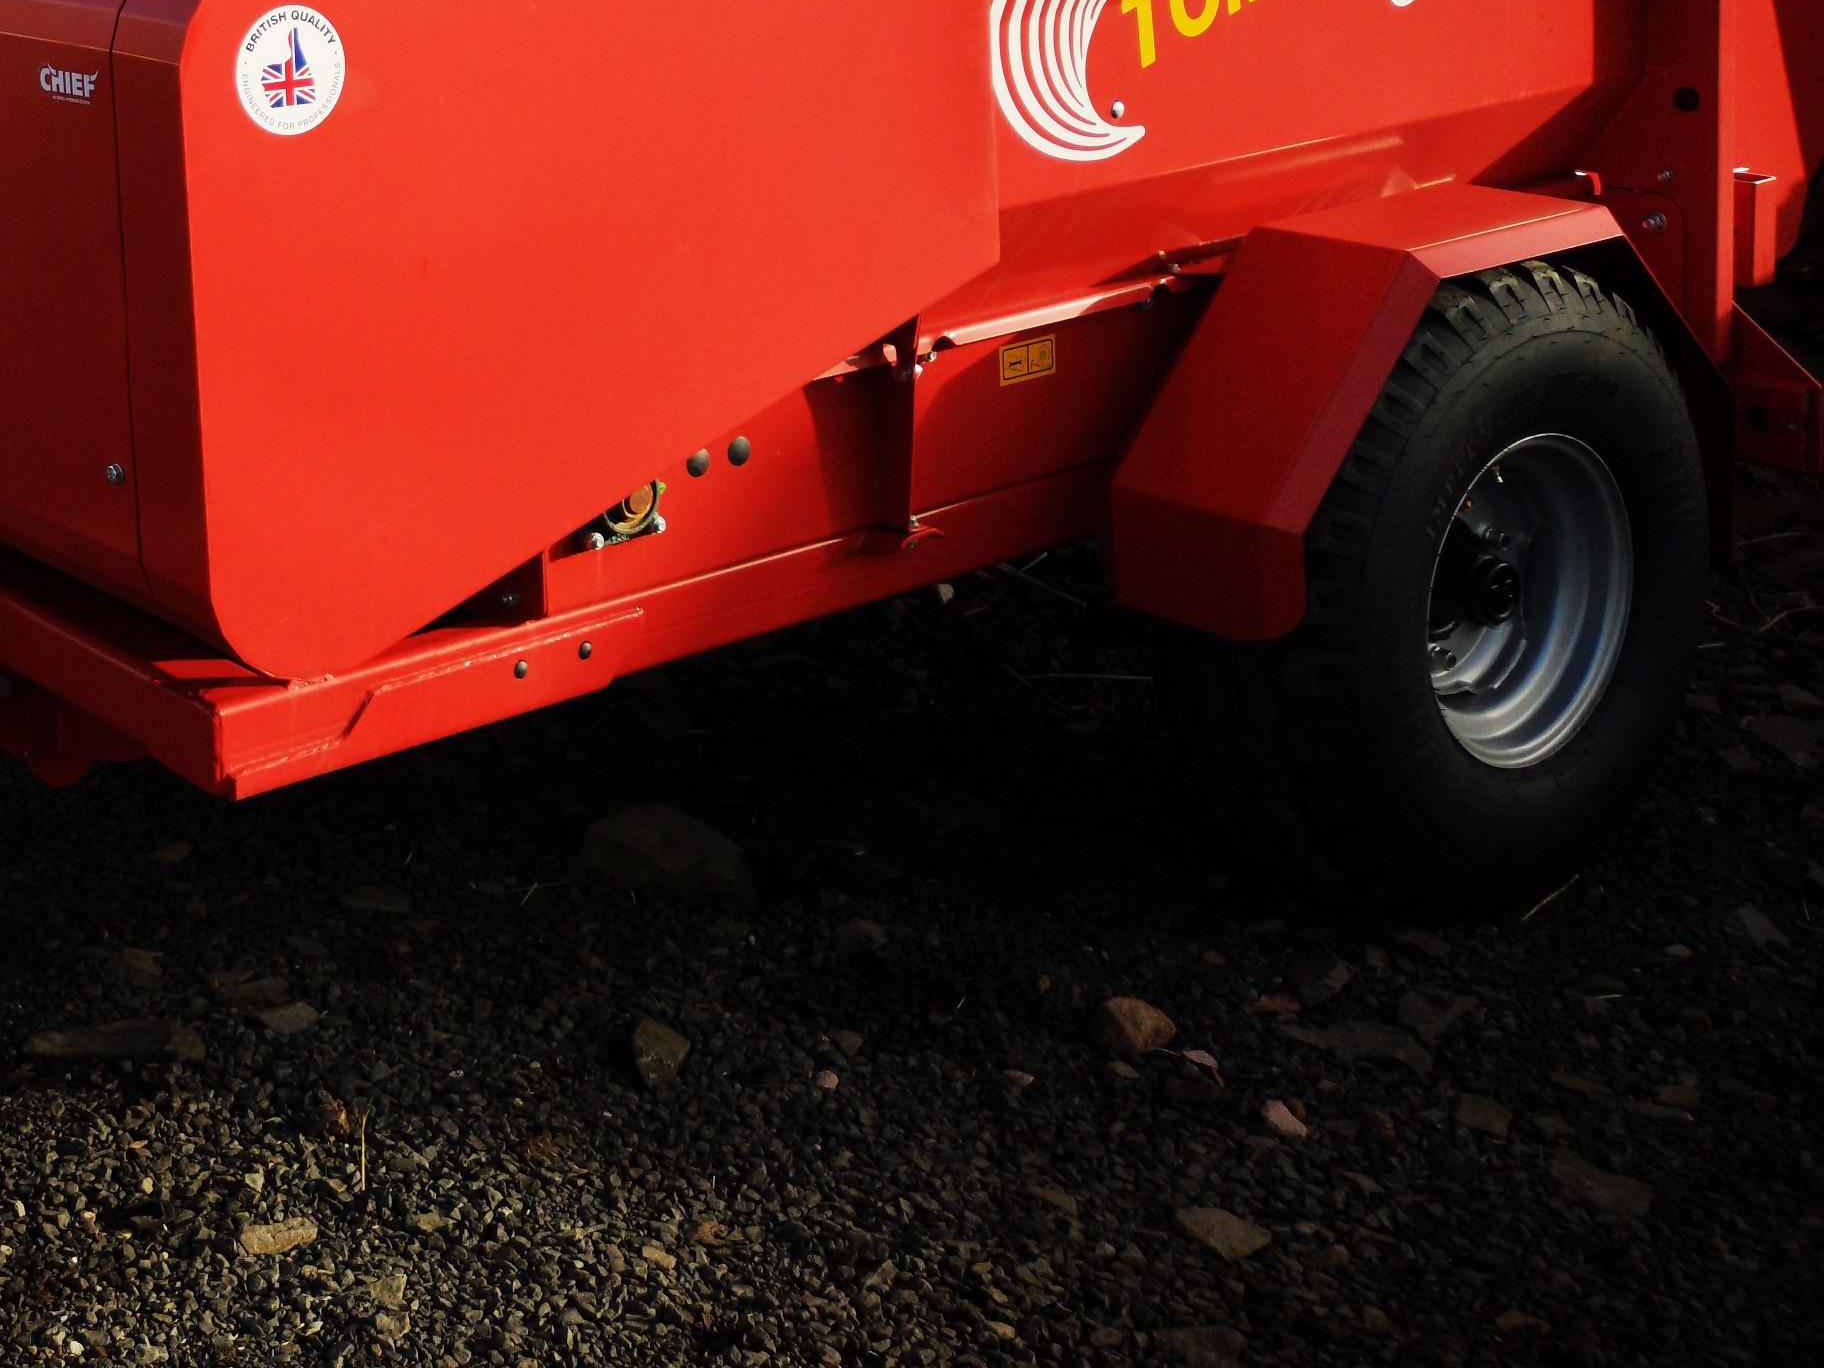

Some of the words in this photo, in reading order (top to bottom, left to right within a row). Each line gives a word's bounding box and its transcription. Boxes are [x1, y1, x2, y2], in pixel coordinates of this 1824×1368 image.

[245, 11, 287, 53] BRITISH
[291, 10, 336, 44] QUALITY
[40, 62, 99, 98] CHIEF
[241, 73, 275, 126] ENGINEERED
[277, 121, 295, 130] FOR
[298, 62, 341, 128] PROFESSIONALS
